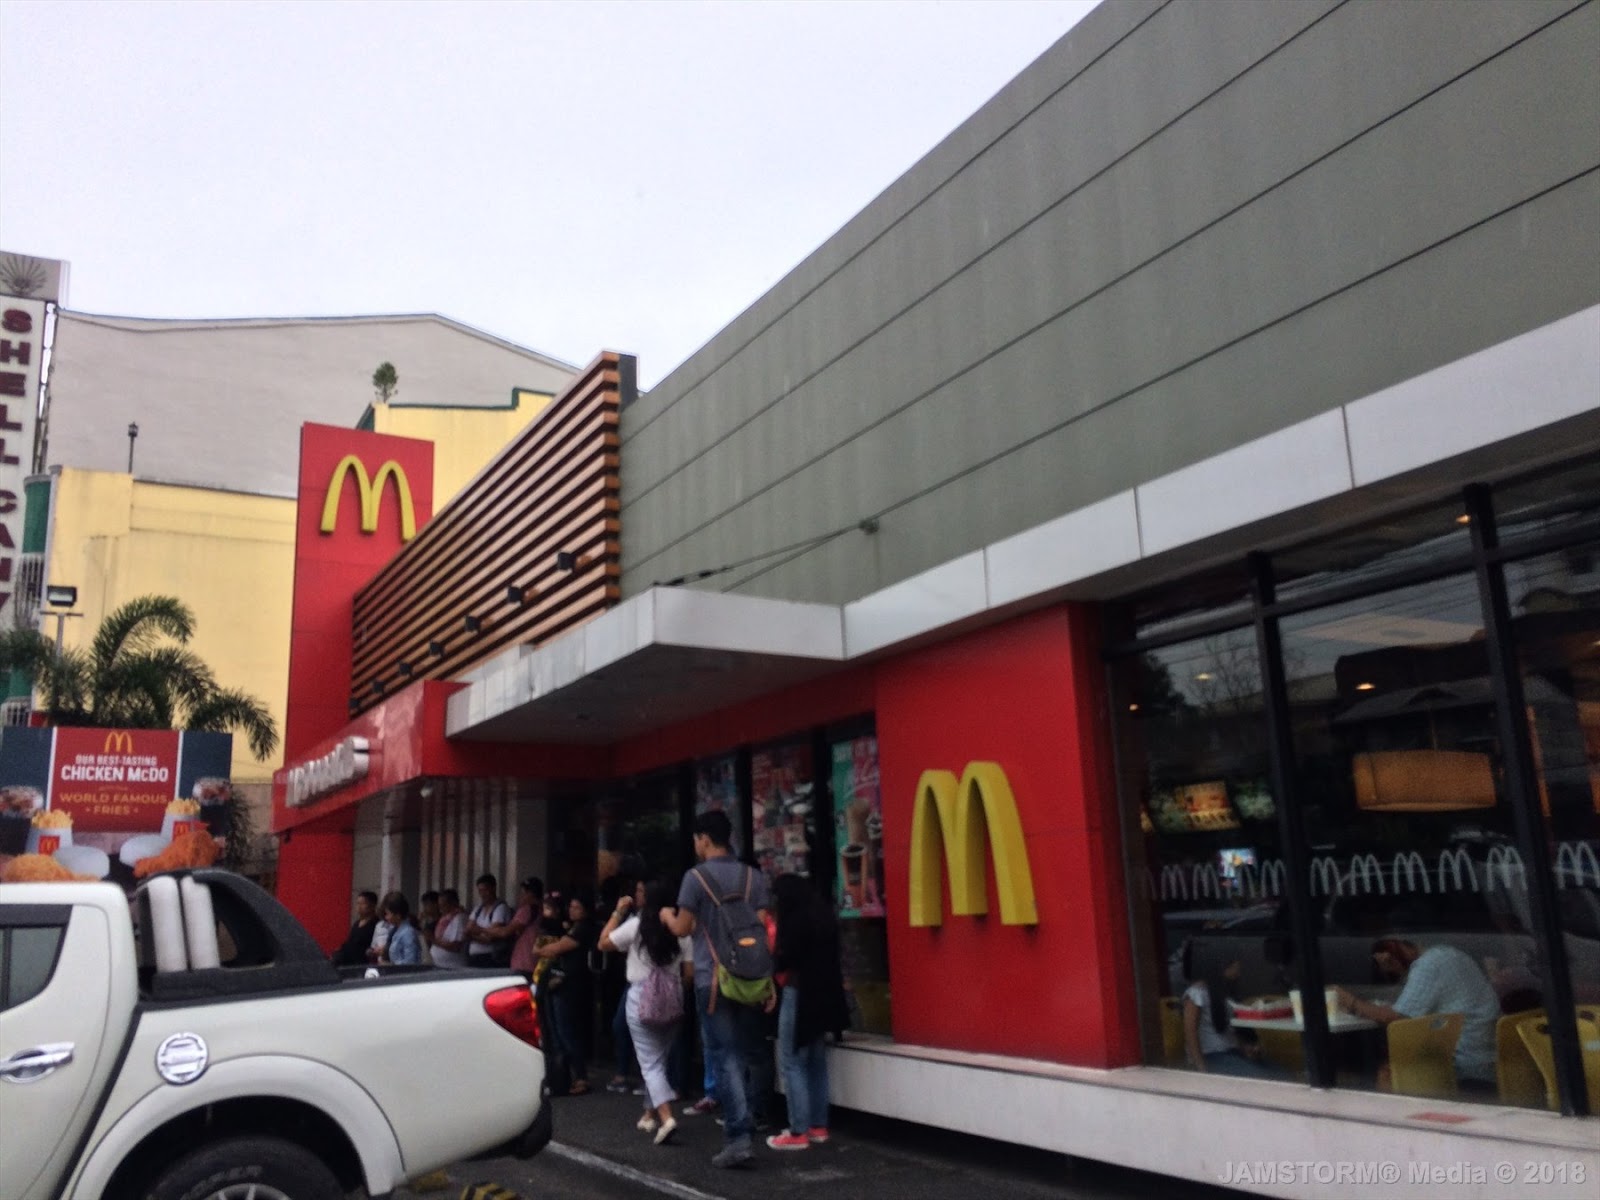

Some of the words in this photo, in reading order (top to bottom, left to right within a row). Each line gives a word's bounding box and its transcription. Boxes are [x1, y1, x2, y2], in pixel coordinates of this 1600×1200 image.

[75, 754, 95, 766] OUR
[97, 754, 157, 767] BEST-TASTING
[61, 765, 124, 781] CHICKEN
[60, 792, 109, 803] WORLD
[113, 793, 168, 804] FAMOUS
[93, 804, 131, 816] FRIES
